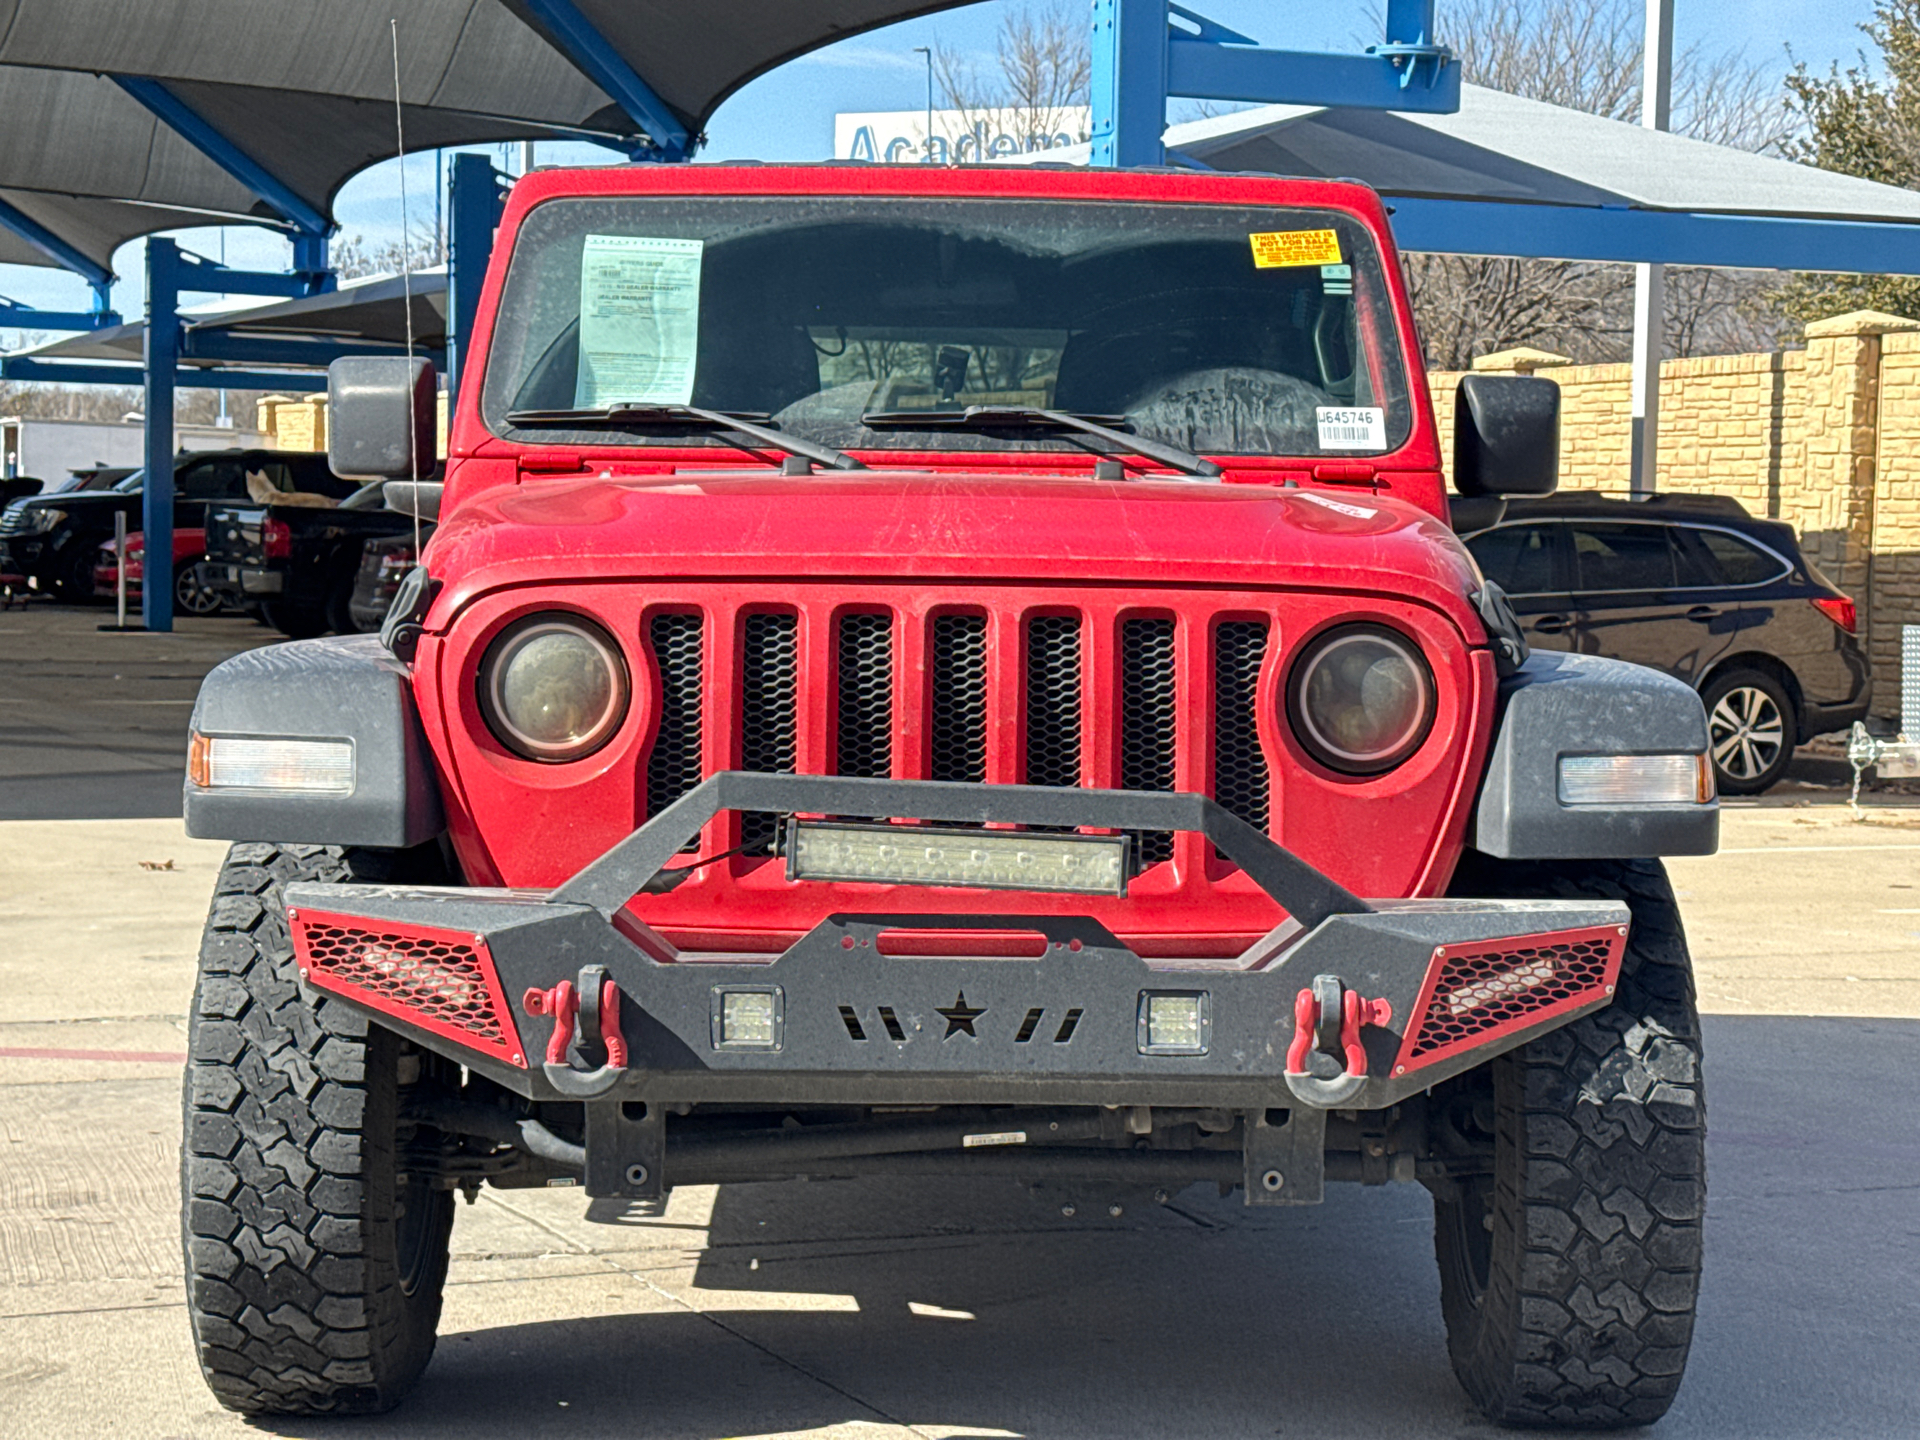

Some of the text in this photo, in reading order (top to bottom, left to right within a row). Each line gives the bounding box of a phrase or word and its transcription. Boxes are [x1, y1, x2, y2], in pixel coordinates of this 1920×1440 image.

[850, 120, 1090, 163] Academ
[1253, 234, 1276, 242] THIS
[1279, 232, 1321, 240] VEHICLE
[1317, 411, 1373, 424] W645746
